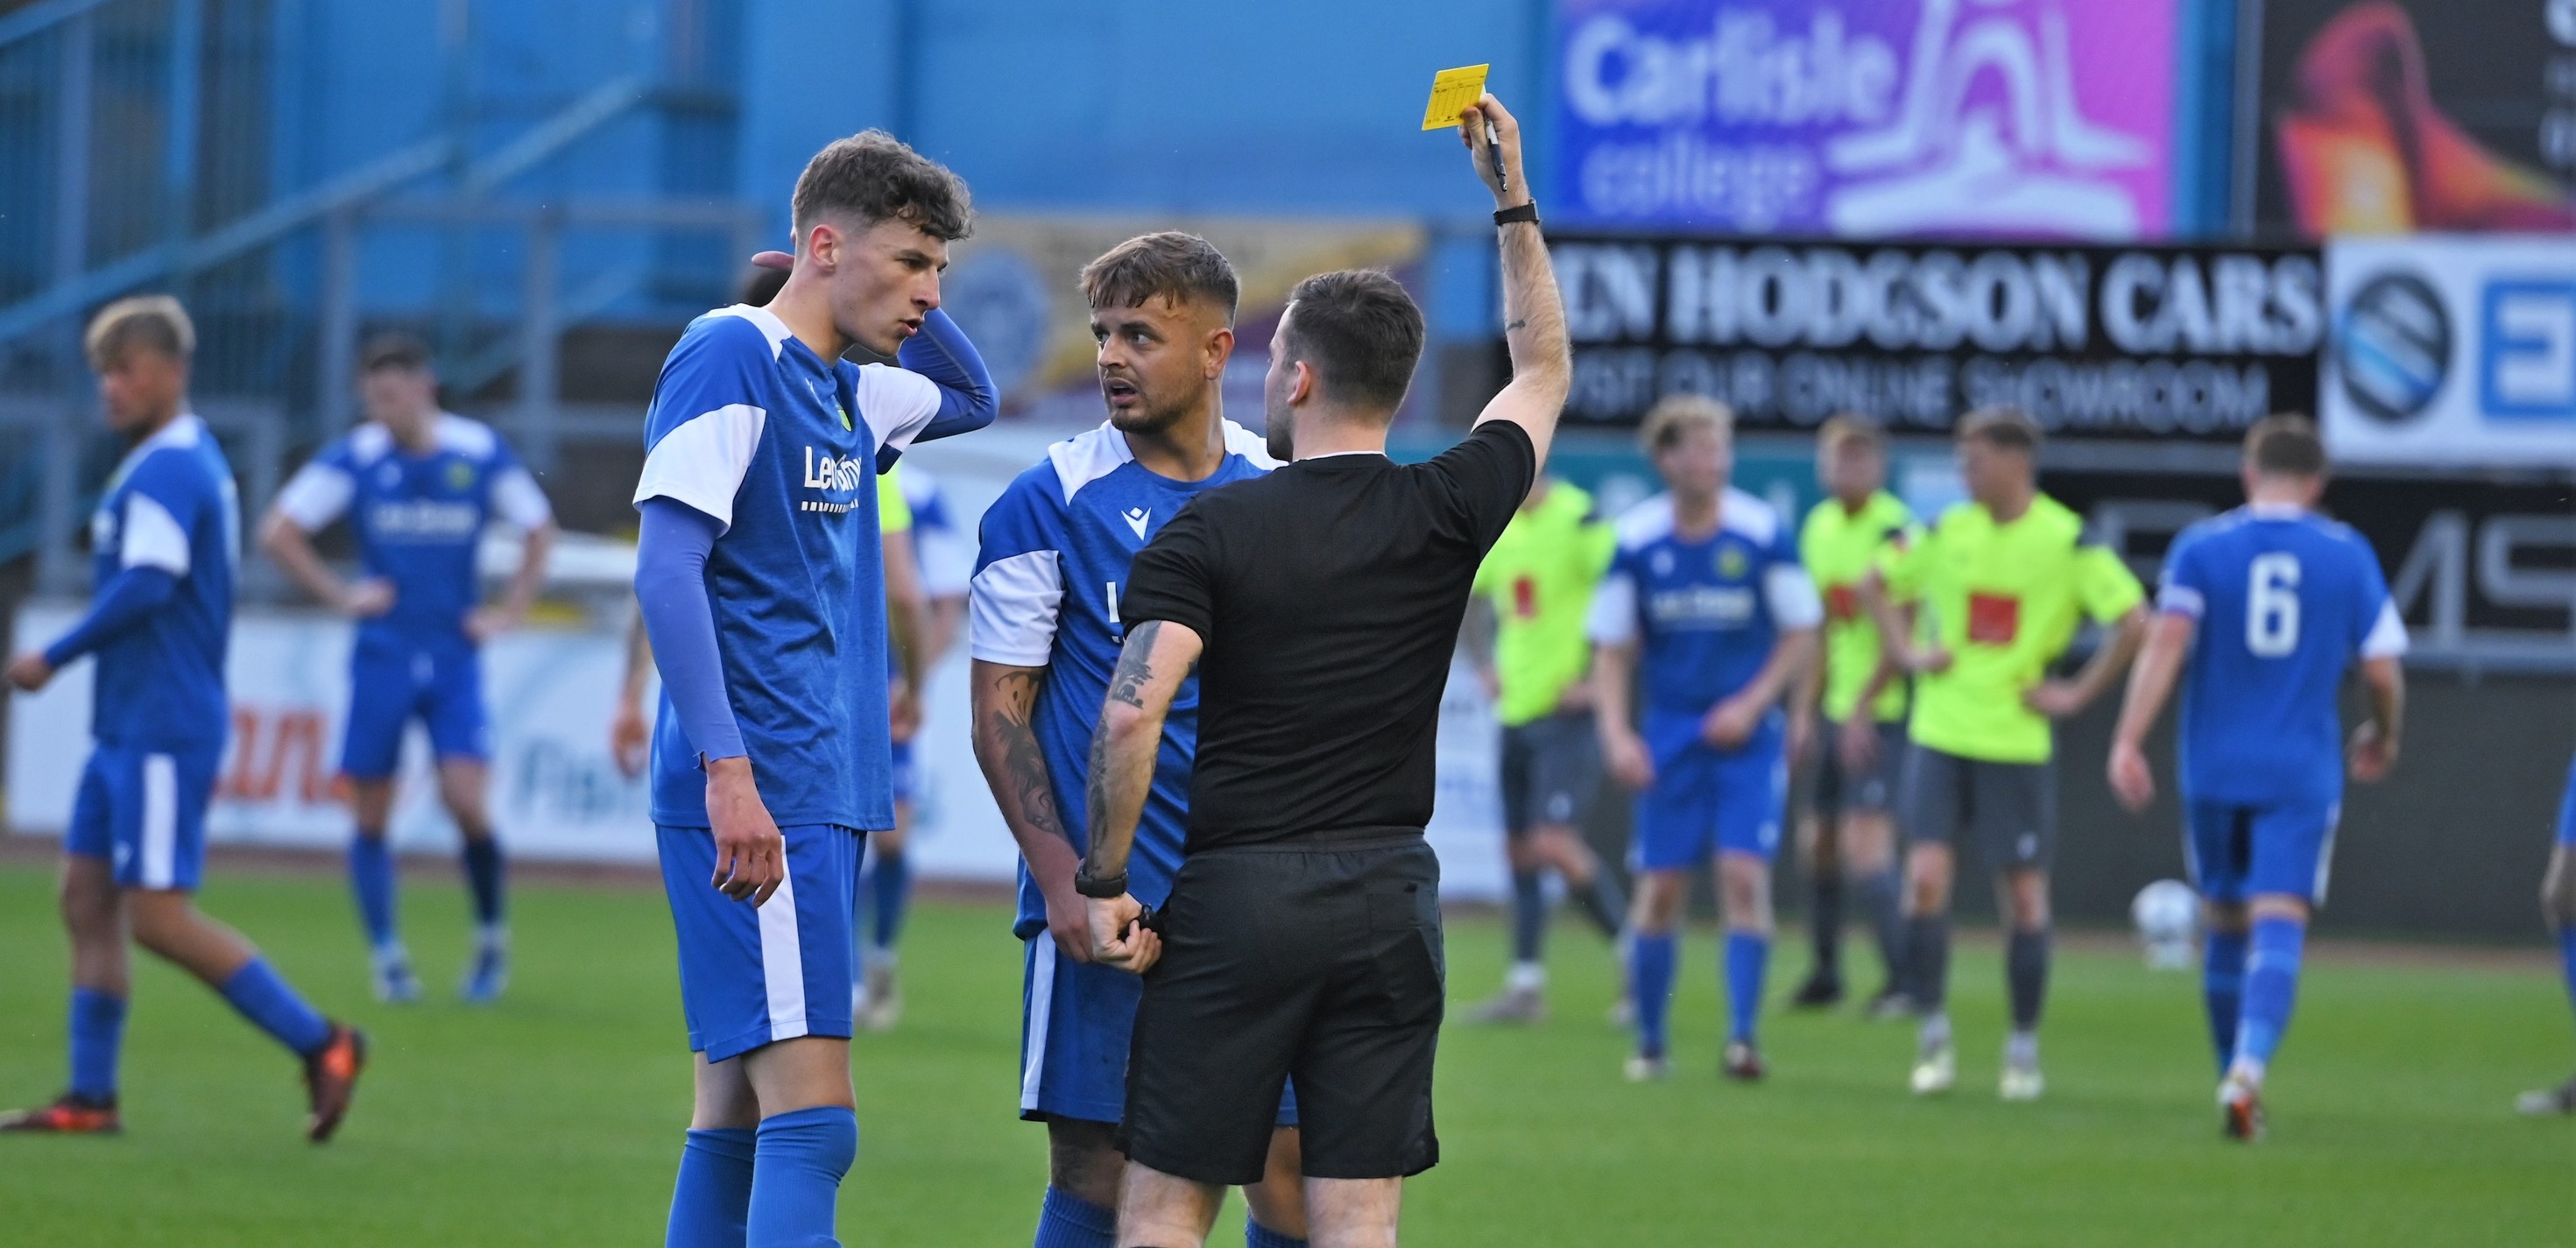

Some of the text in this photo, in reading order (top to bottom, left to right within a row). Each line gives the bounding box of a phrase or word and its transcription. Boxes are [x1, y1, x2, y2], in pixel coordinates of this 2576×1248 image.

[1567, 9, 1895, 124] Carlisle
[1581, 132, 1817, 233] college
[1549, 243, 2323, 354] EN HODGSON CARS
[1781, 351, 1952, 428] ONLINE
[1962, 356, 2270, 432] SHOWROOM
[2245, 551, 2301, 659] 6
